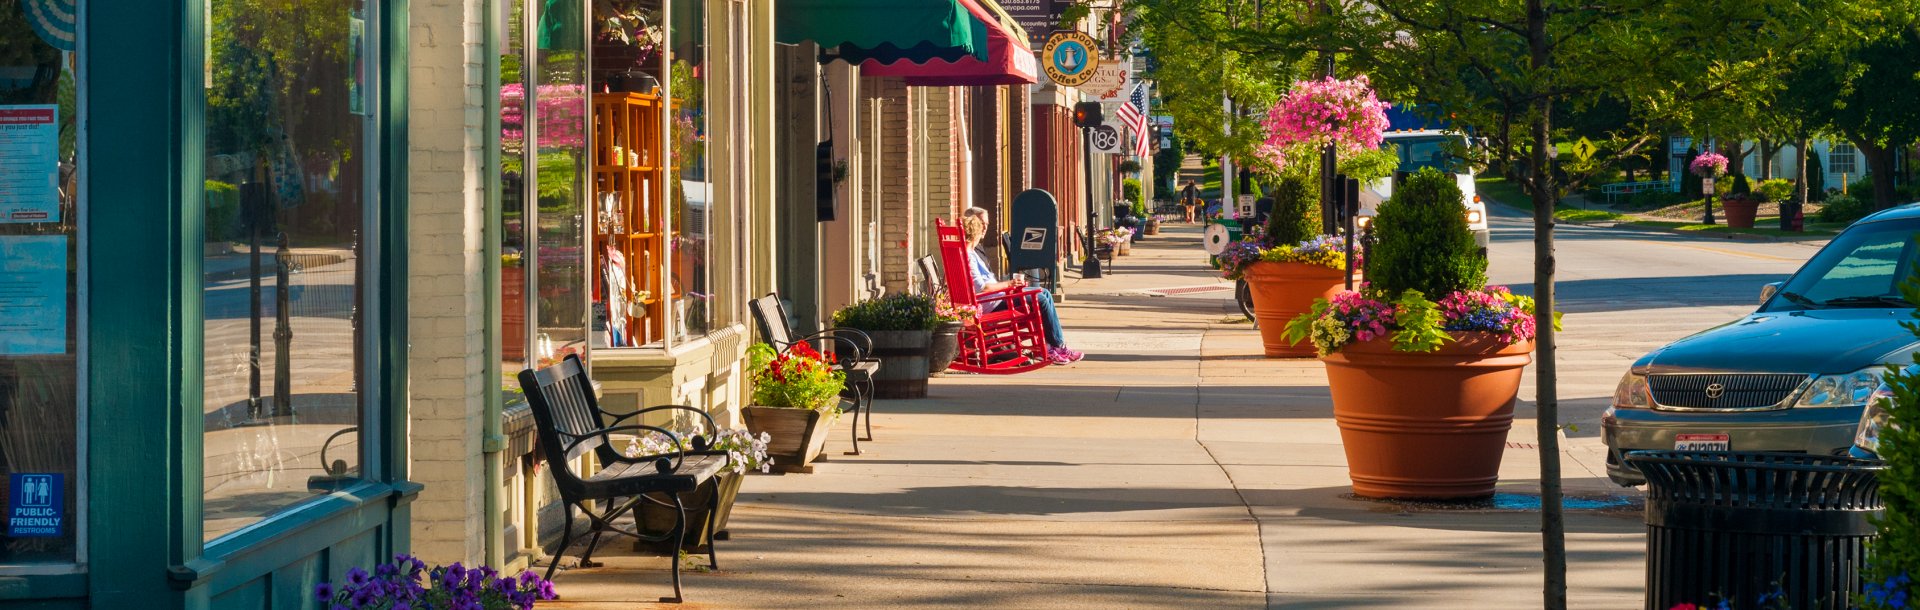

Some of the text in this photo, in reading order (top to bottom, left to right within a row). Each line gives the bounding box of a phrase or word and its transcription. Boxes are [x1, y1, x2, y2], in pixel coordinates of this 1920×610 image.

[1046, 32, 1095, 52] OPEN DOOR
[1047, 66, 1094, 84] Coffee Co.
[1094, 131, 1117, 149] 186
[15, 508, 56, 516] PUBLIC-
[10, 517, 61, 526] FRIENDLY
